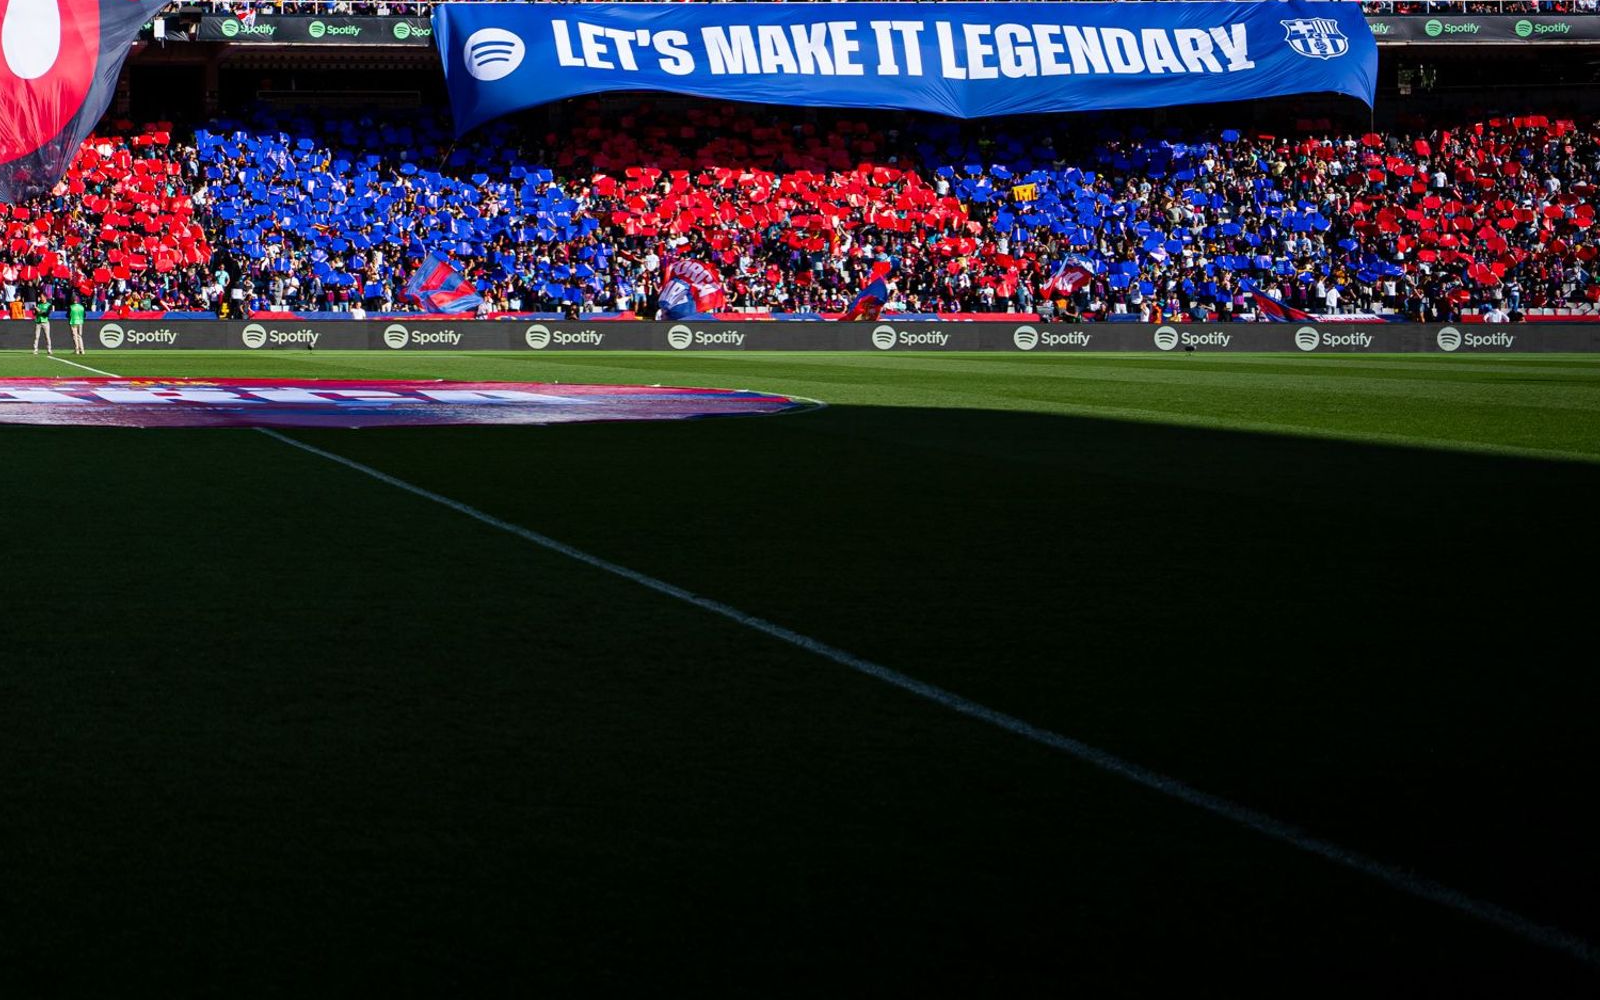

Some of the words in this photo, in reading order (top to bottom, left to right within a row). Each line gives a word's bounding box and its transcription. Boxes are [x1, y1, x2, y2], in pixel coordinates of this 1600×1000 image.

[327, 25, 361, 36] Spotify
[1444, 22, 1479, 34] Spotify
[1534, 23, 1569, 35] Spotify
[552, 20, 695, 75] LET'S
[701, 21, 864, 75] MAKE
[870, 21, 923, 76] IT
[936, 21, 1255, 79] LEGENDARY
[127, 331, 177, 345] Spotify
[270, 331, 321, 345] Spotify
[412, 331, 463, 345] Spotify
[553, 331, 604, 345] Spotify
[695, 331, 745, 345] Spotify
[899, 331, 950, 346] Spotify
[1041, 332, 1092, 346] Spotify
[1181, 332, 1231, 346] Spotify
[1323, 332, 1373, 346] Spotify
[1465, 332, 1514, 346] Spotify
